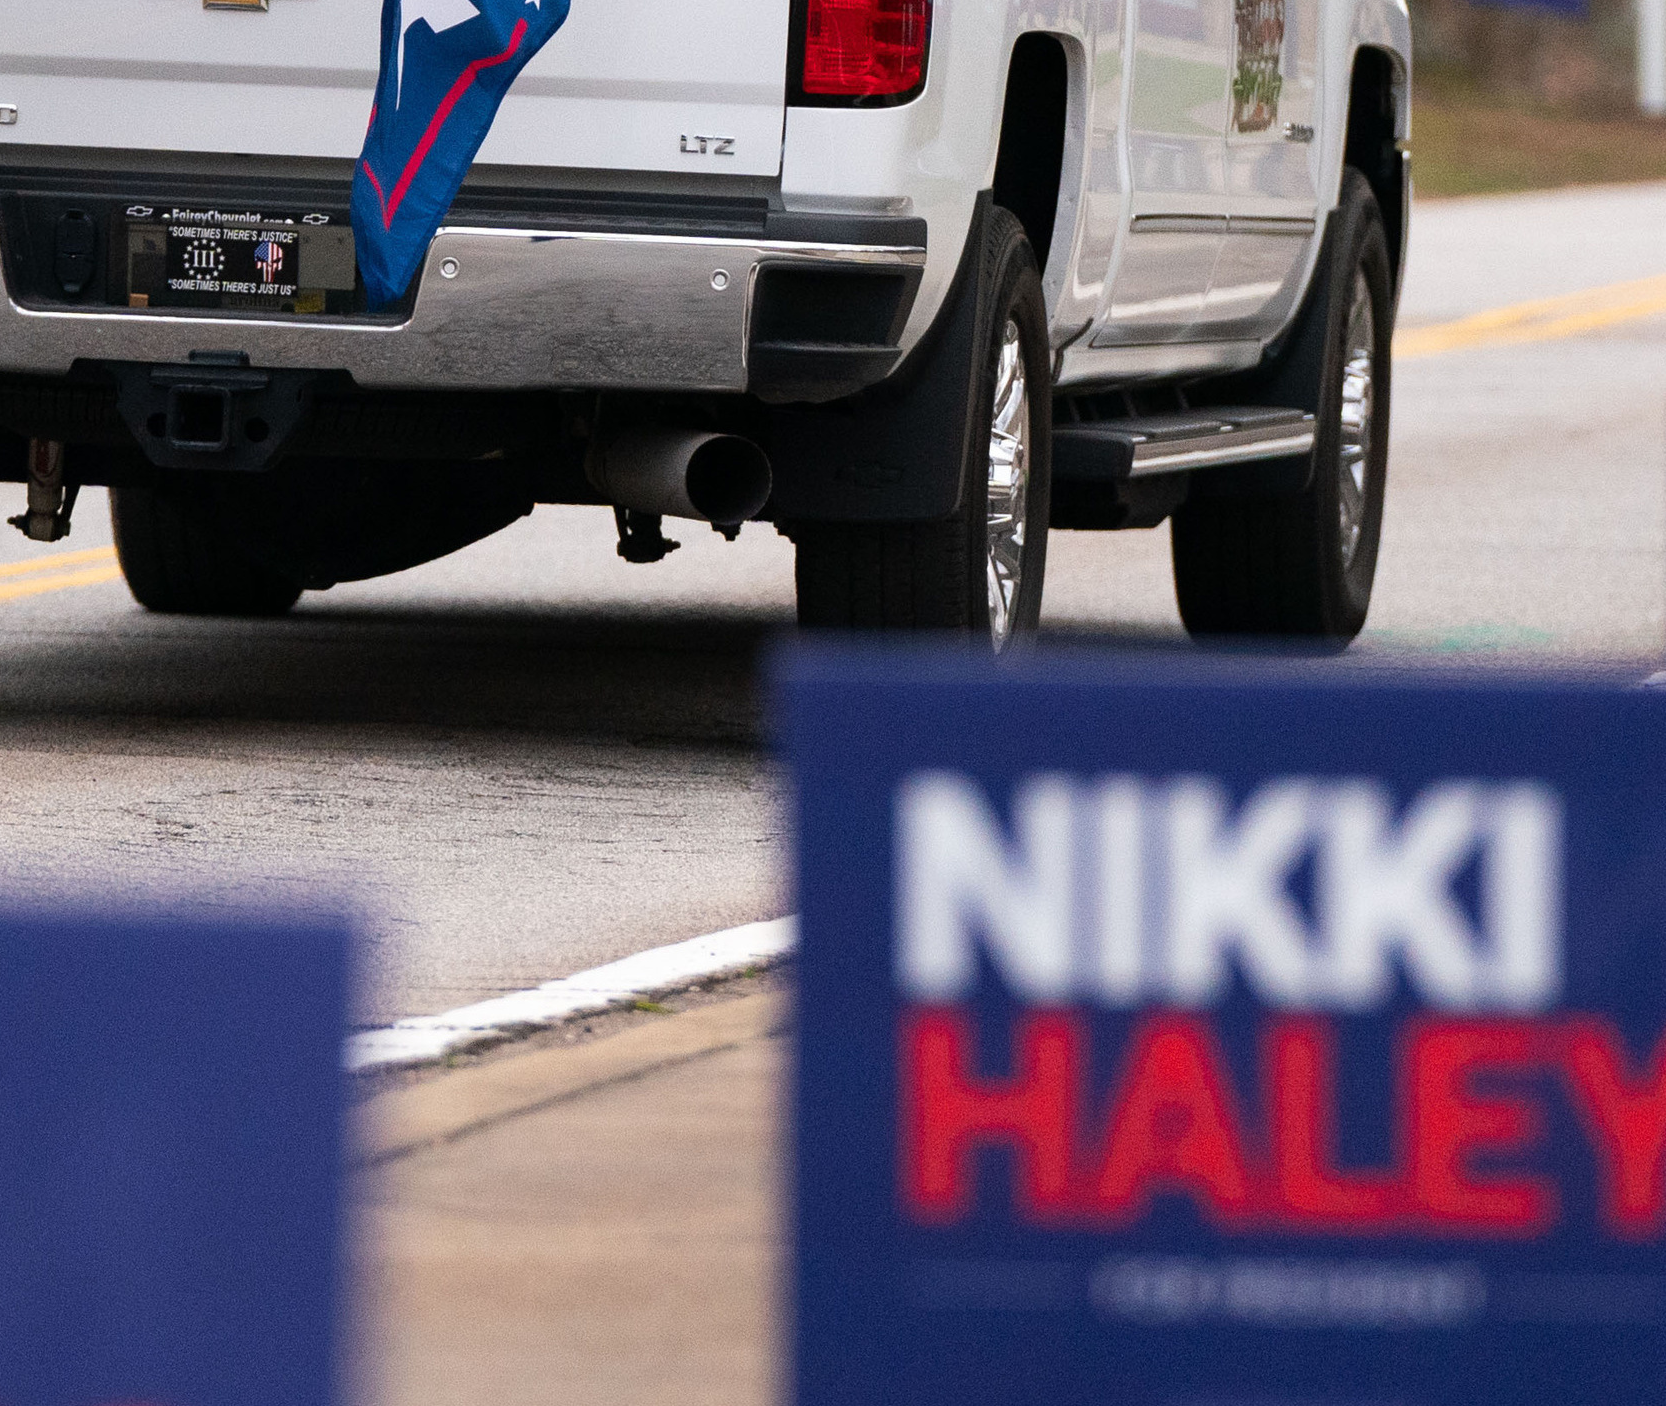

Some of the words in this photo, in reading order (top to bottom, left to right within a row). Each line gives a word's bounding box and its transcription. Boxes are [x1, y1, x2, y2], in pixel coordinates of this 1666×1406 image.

[679, 134, 735, 155] LTZ
[223, 228, 258, 242] THERE'S
[222, 281, 257, 293] THERE'S
[257, 283, 279, 294] JUST
[897, 772, 1561, 1011] NIKKI
